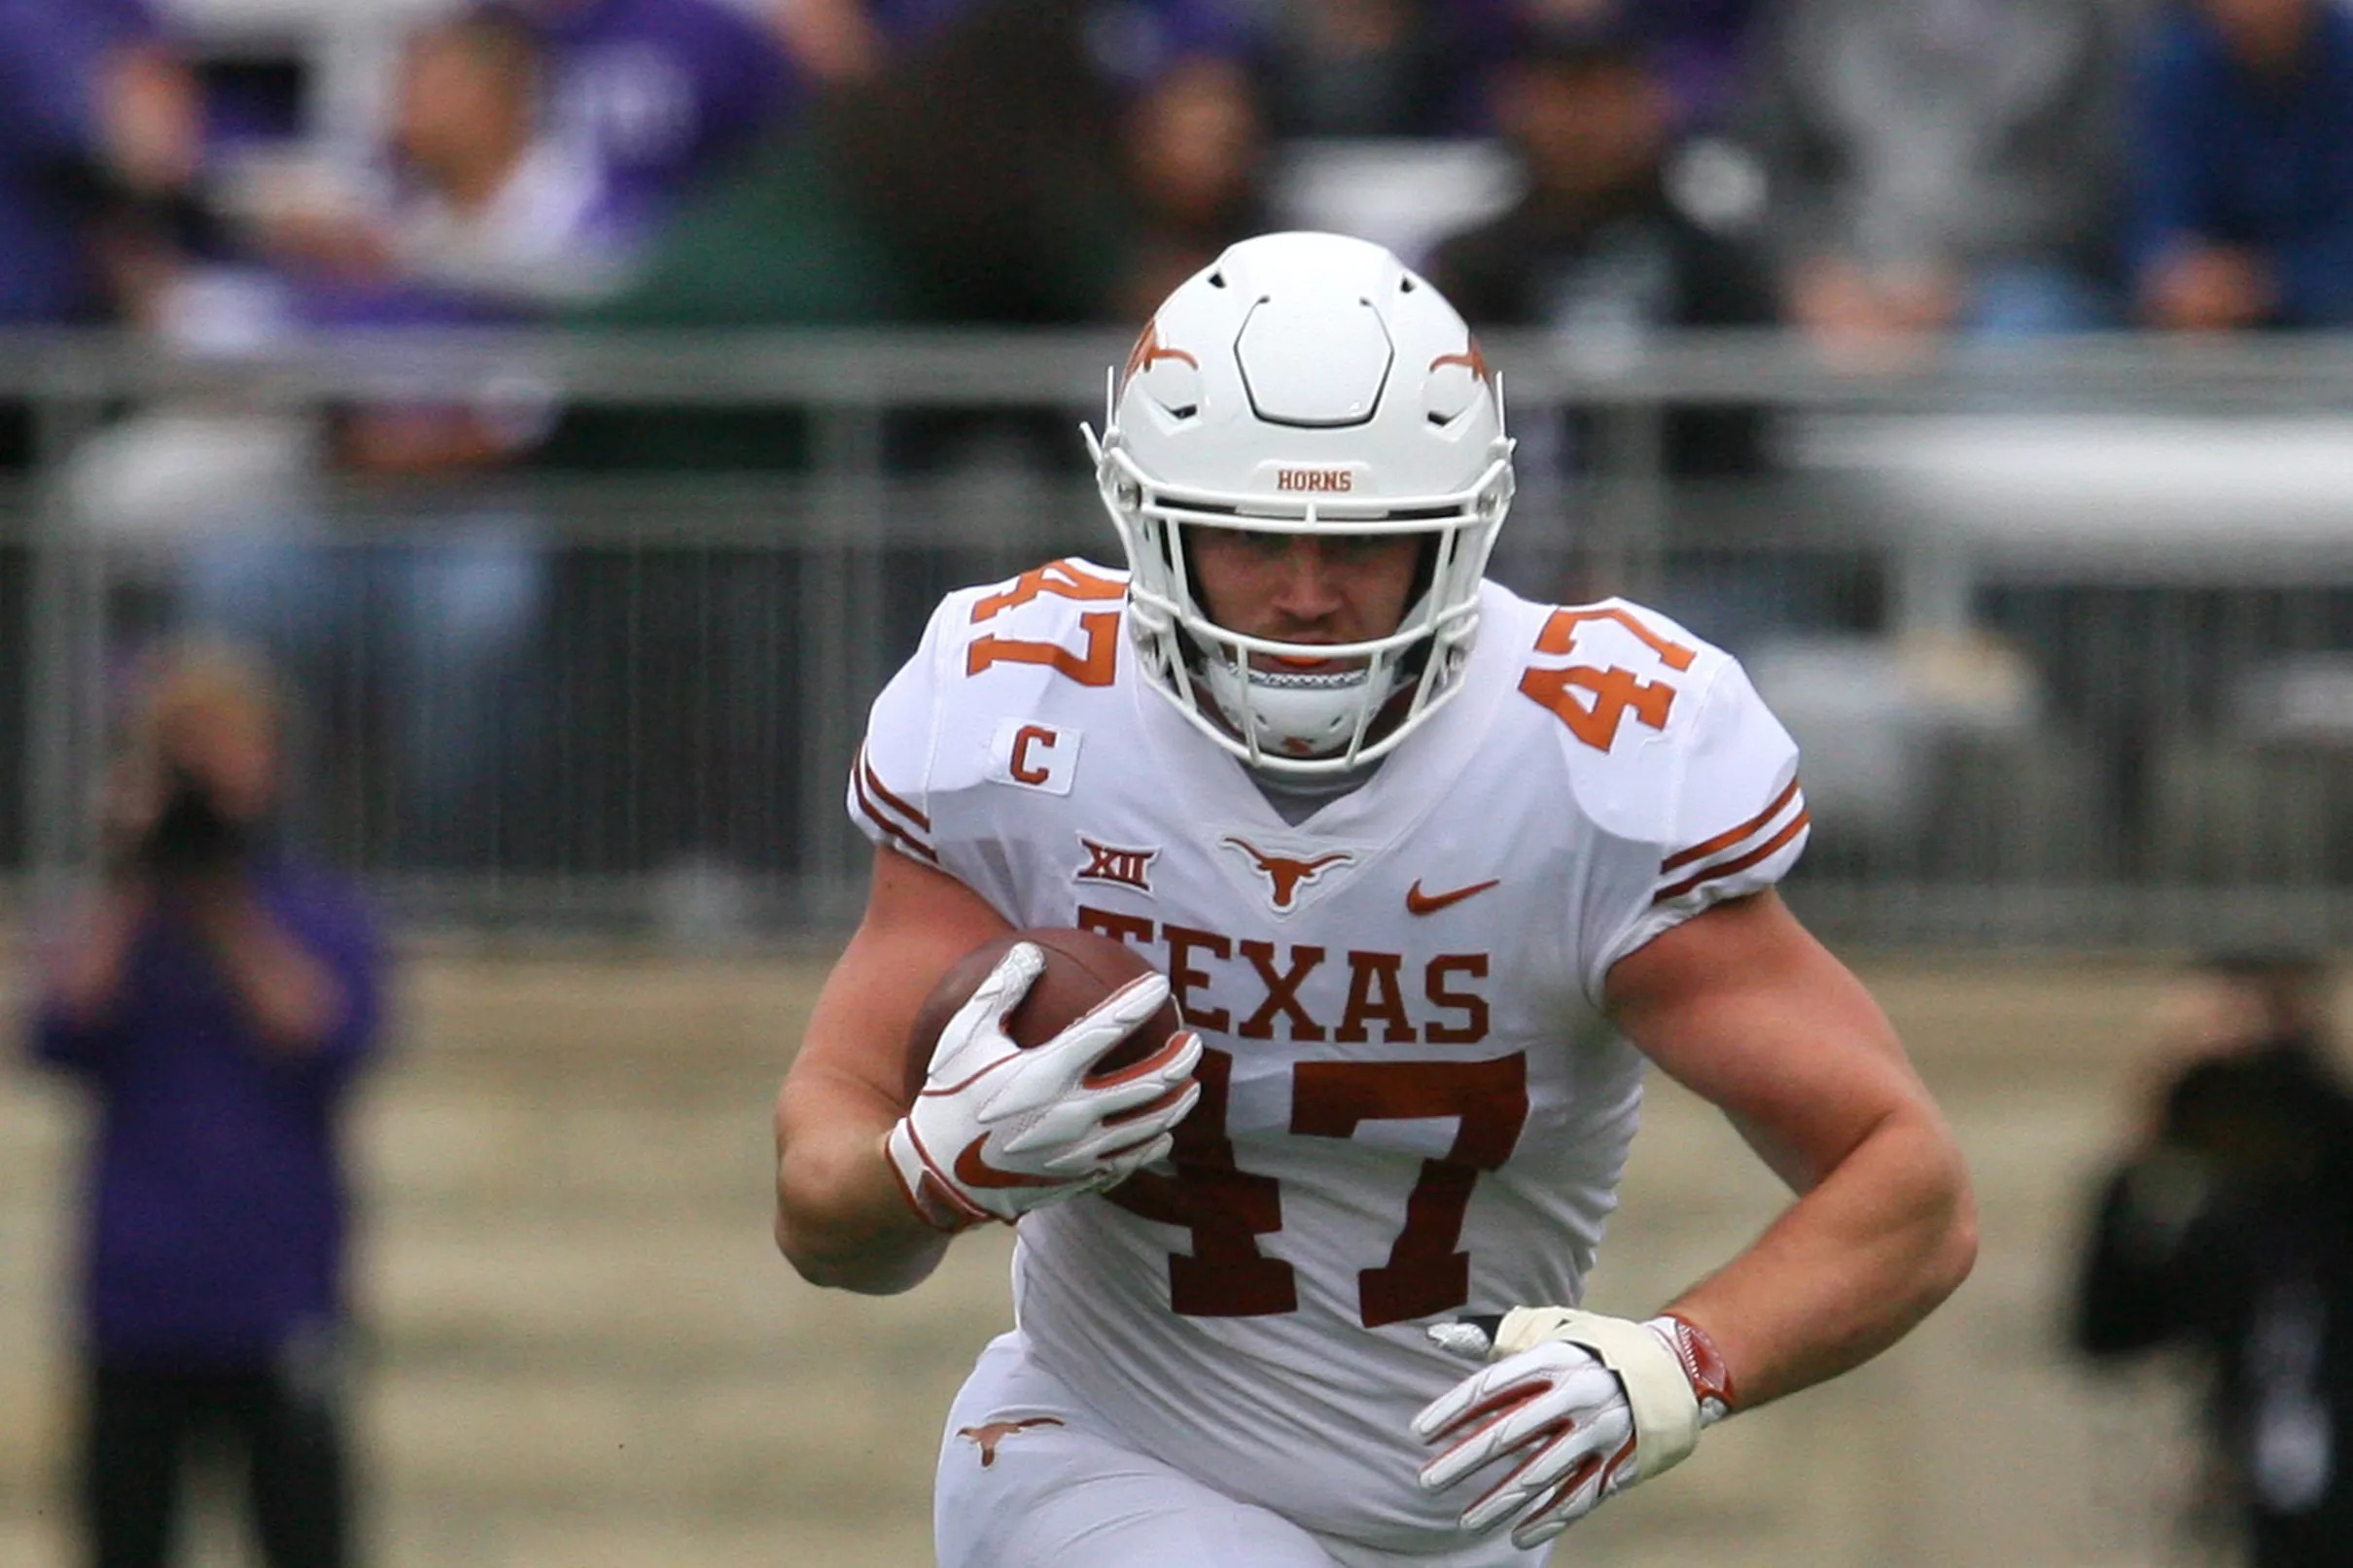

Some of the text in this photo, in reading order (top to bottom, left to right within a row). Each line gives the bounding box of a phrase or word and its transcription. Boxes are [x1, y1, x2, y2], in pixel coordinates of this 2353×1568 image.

[1277, 469, 1352, 492] HORNS
[966, 558, 1128, 686] 47
[1518, 607, 1695, 752] 47
[1009, 724, 1057, 784] C
[1076, 838, 1155, 891] XII
[1101, 1045, 1528, 1328] 47
